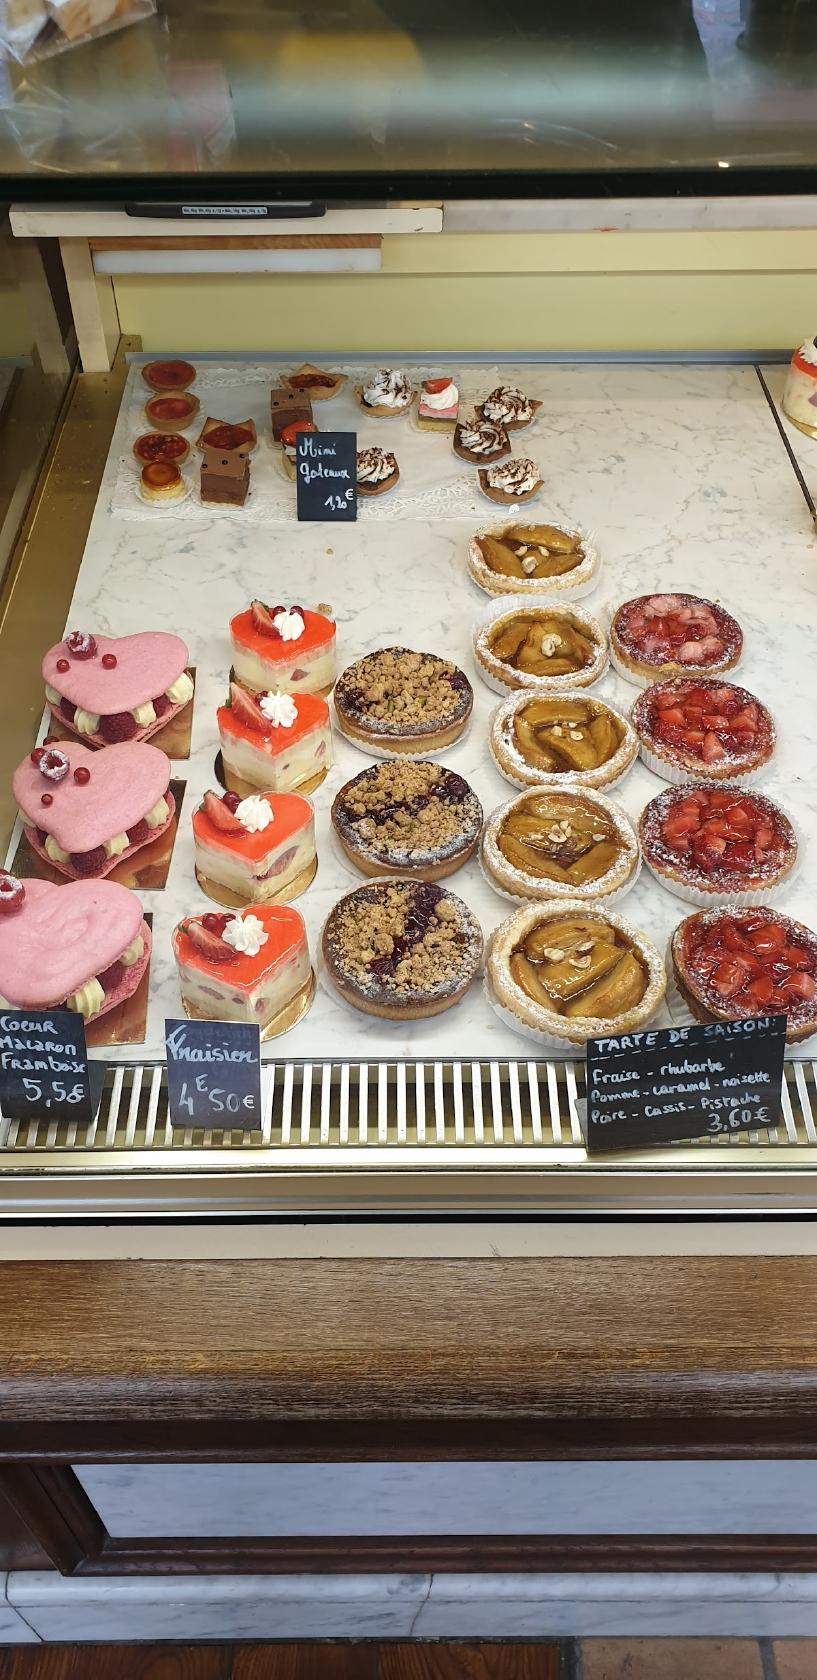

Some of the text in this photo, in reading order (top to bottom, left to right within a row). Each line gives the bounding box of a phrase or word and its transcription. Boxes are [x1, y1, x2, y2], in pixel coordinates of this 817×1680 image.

[300, 437, 336, 457] Mini
[594, 1032, 659, 1052] TARTE
[669, 1028, 691, 1043] DE
[592, 1069, 640, 1085] Fraise
[660, 1058, 726, 1075] rhubarbe
[591, 1089, 641, 1103] Pomme
[652, 1077, 711, 1096] caramel
[722, 1071, 771, 1087] noisette
[591, 1109, 627, 1124] Poire
[644, 1101, 686, 1117] Cassis
[701, 1092, 760, 1110] Pistache
